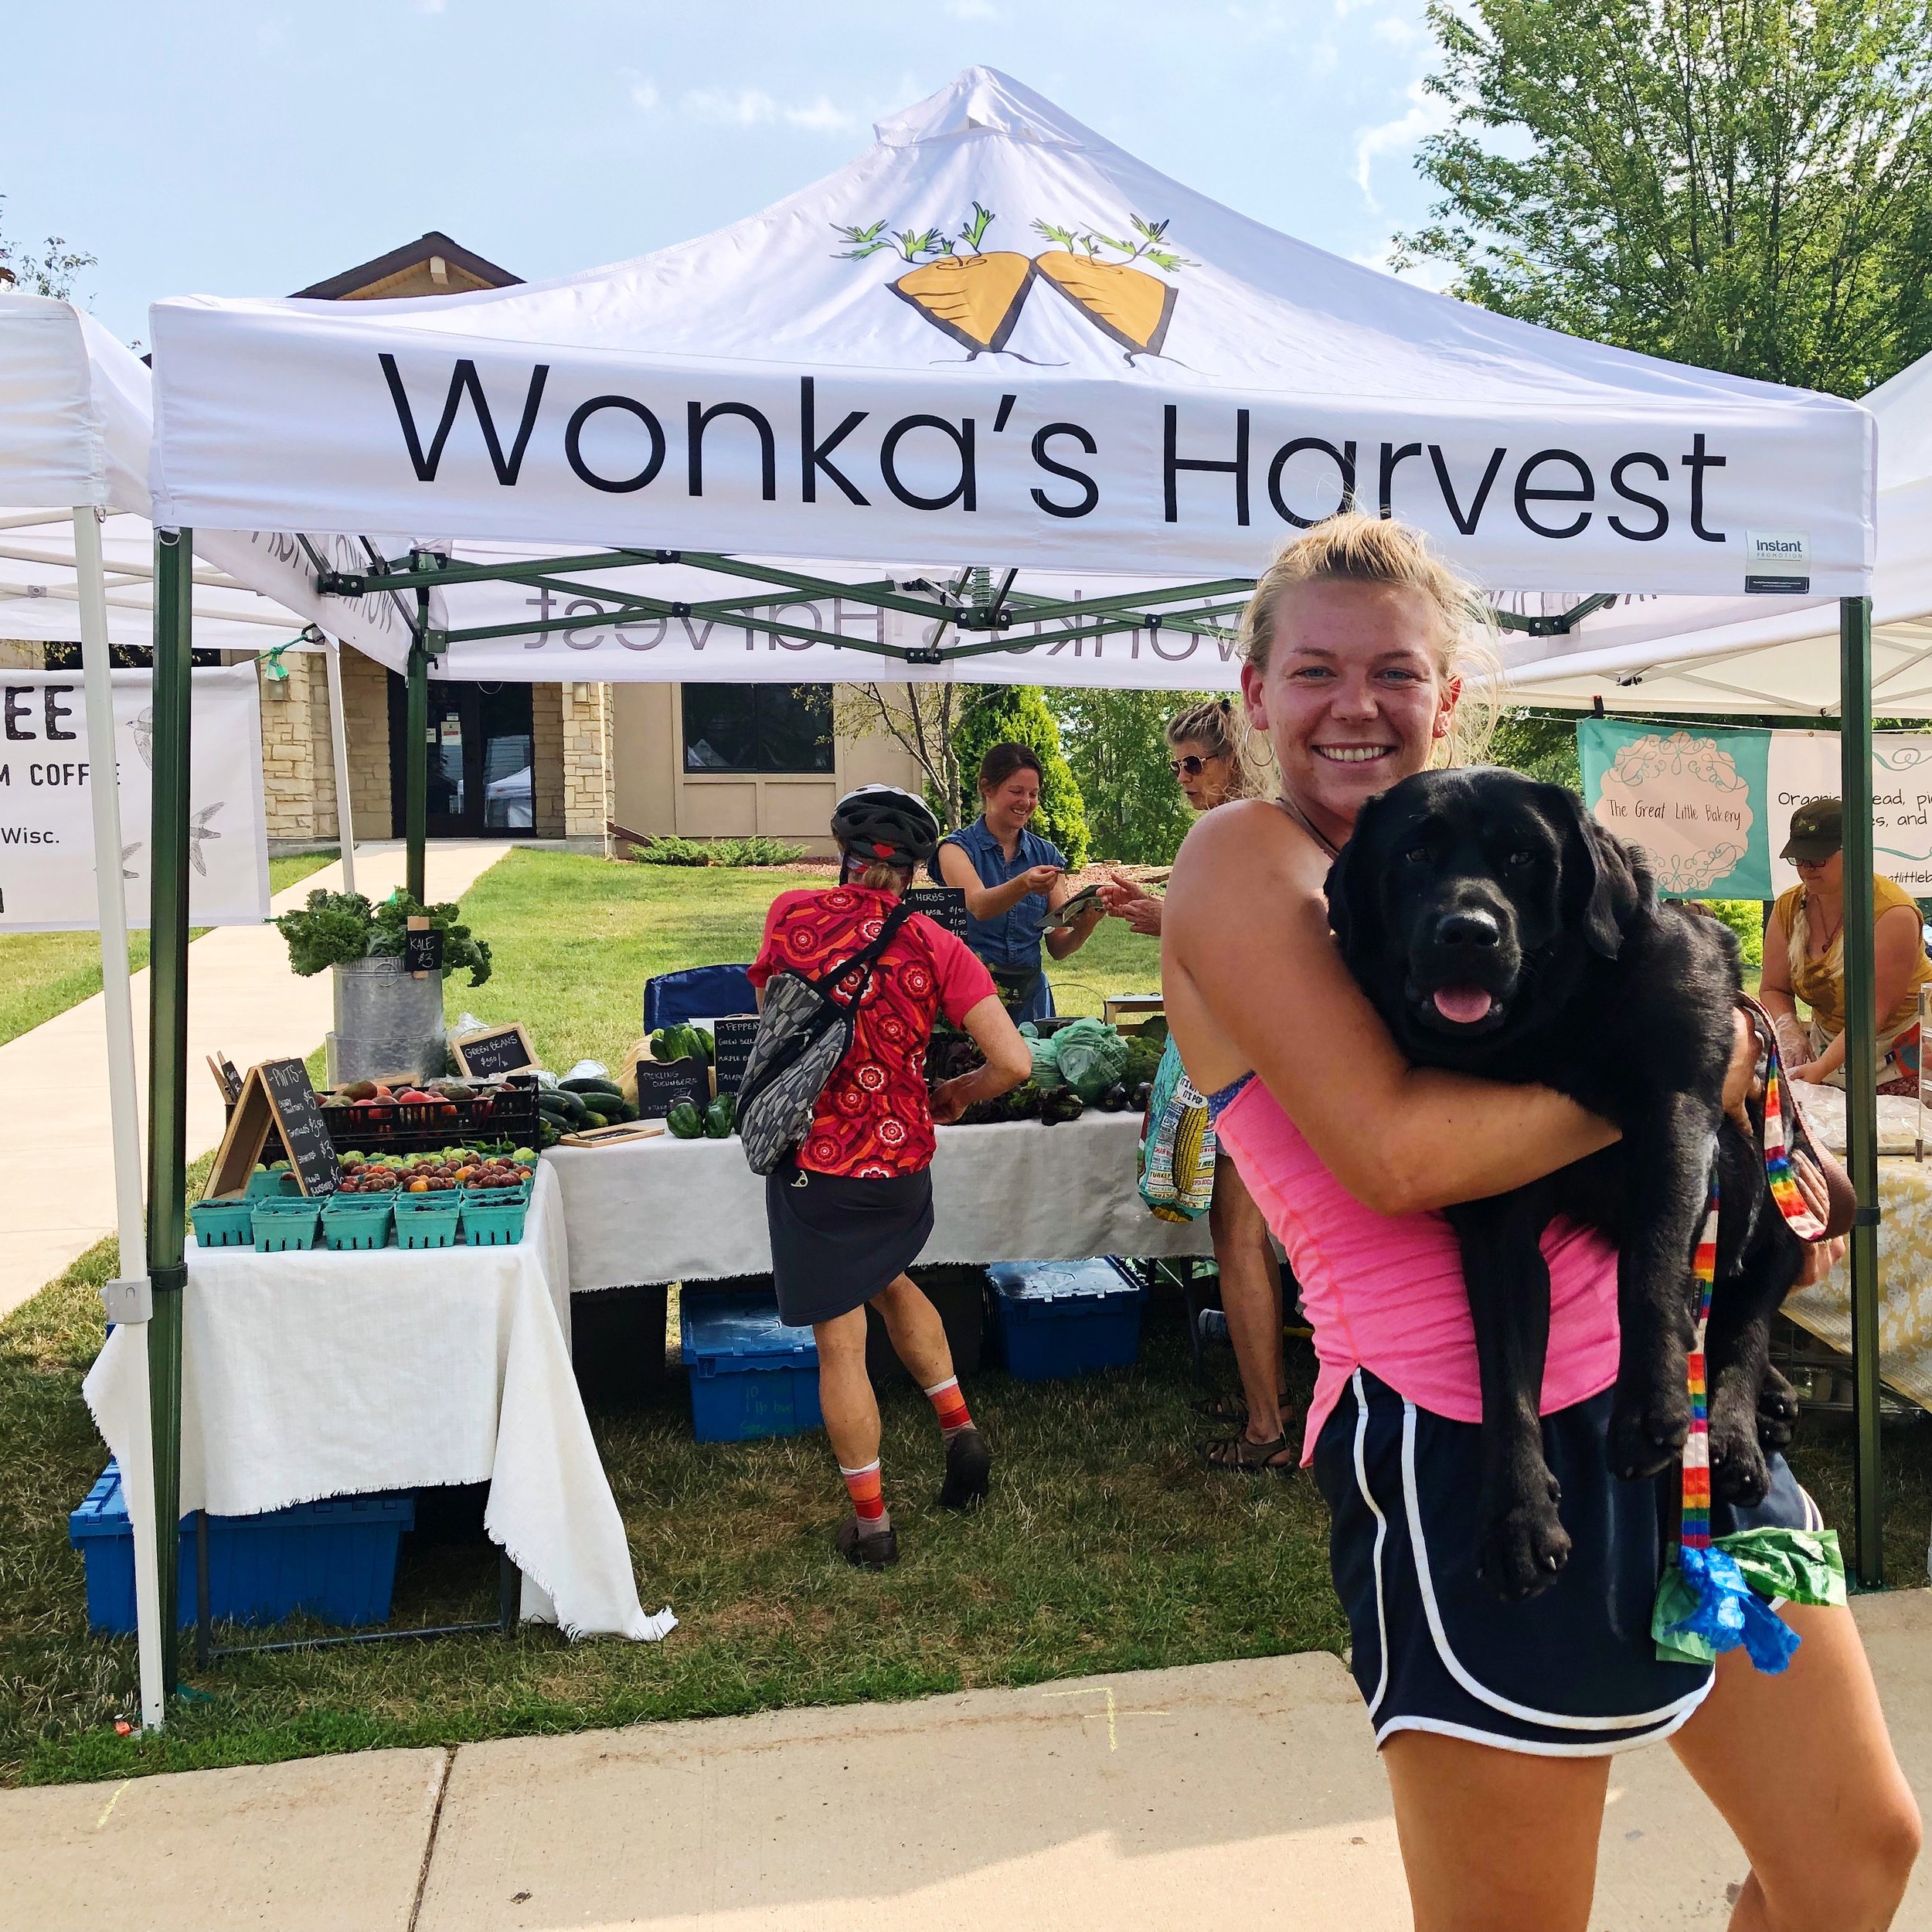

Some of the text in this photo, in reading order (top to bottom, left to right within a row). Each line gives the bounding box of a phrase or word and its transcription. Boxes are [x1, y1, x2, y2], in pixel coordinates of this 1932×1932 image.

[377, 353, 1727, 542] Wonka's Harvest
[1757, 539, 1802, 553] Instant
[1872, 788, 1906, 807] ead,
[1607, 799, 1741, 831] The Great Little Bakery
[1897, 809, 1929, 825] and
[1, 827, 60, 845] Wisc.
[915, 893, 945, 903] HERBS
[410, 936, 435, 951] KALE
[417, 952, 434, 968] $3
[725, 1022, 761, 1032] PEPPER
[464, 1035, 518, 1059] GREEN BEANS
[718, 1038, 740, 1046] GREEN
[272, 1064, 300, 1087] PINTS
[643, 1071, 679, 1082] PICKLING
[652, 1077, 698, 1088] CUCUMBERS
[302, 1087, 317, 1111] $5
[319, 1139, 335, 1160] $3
